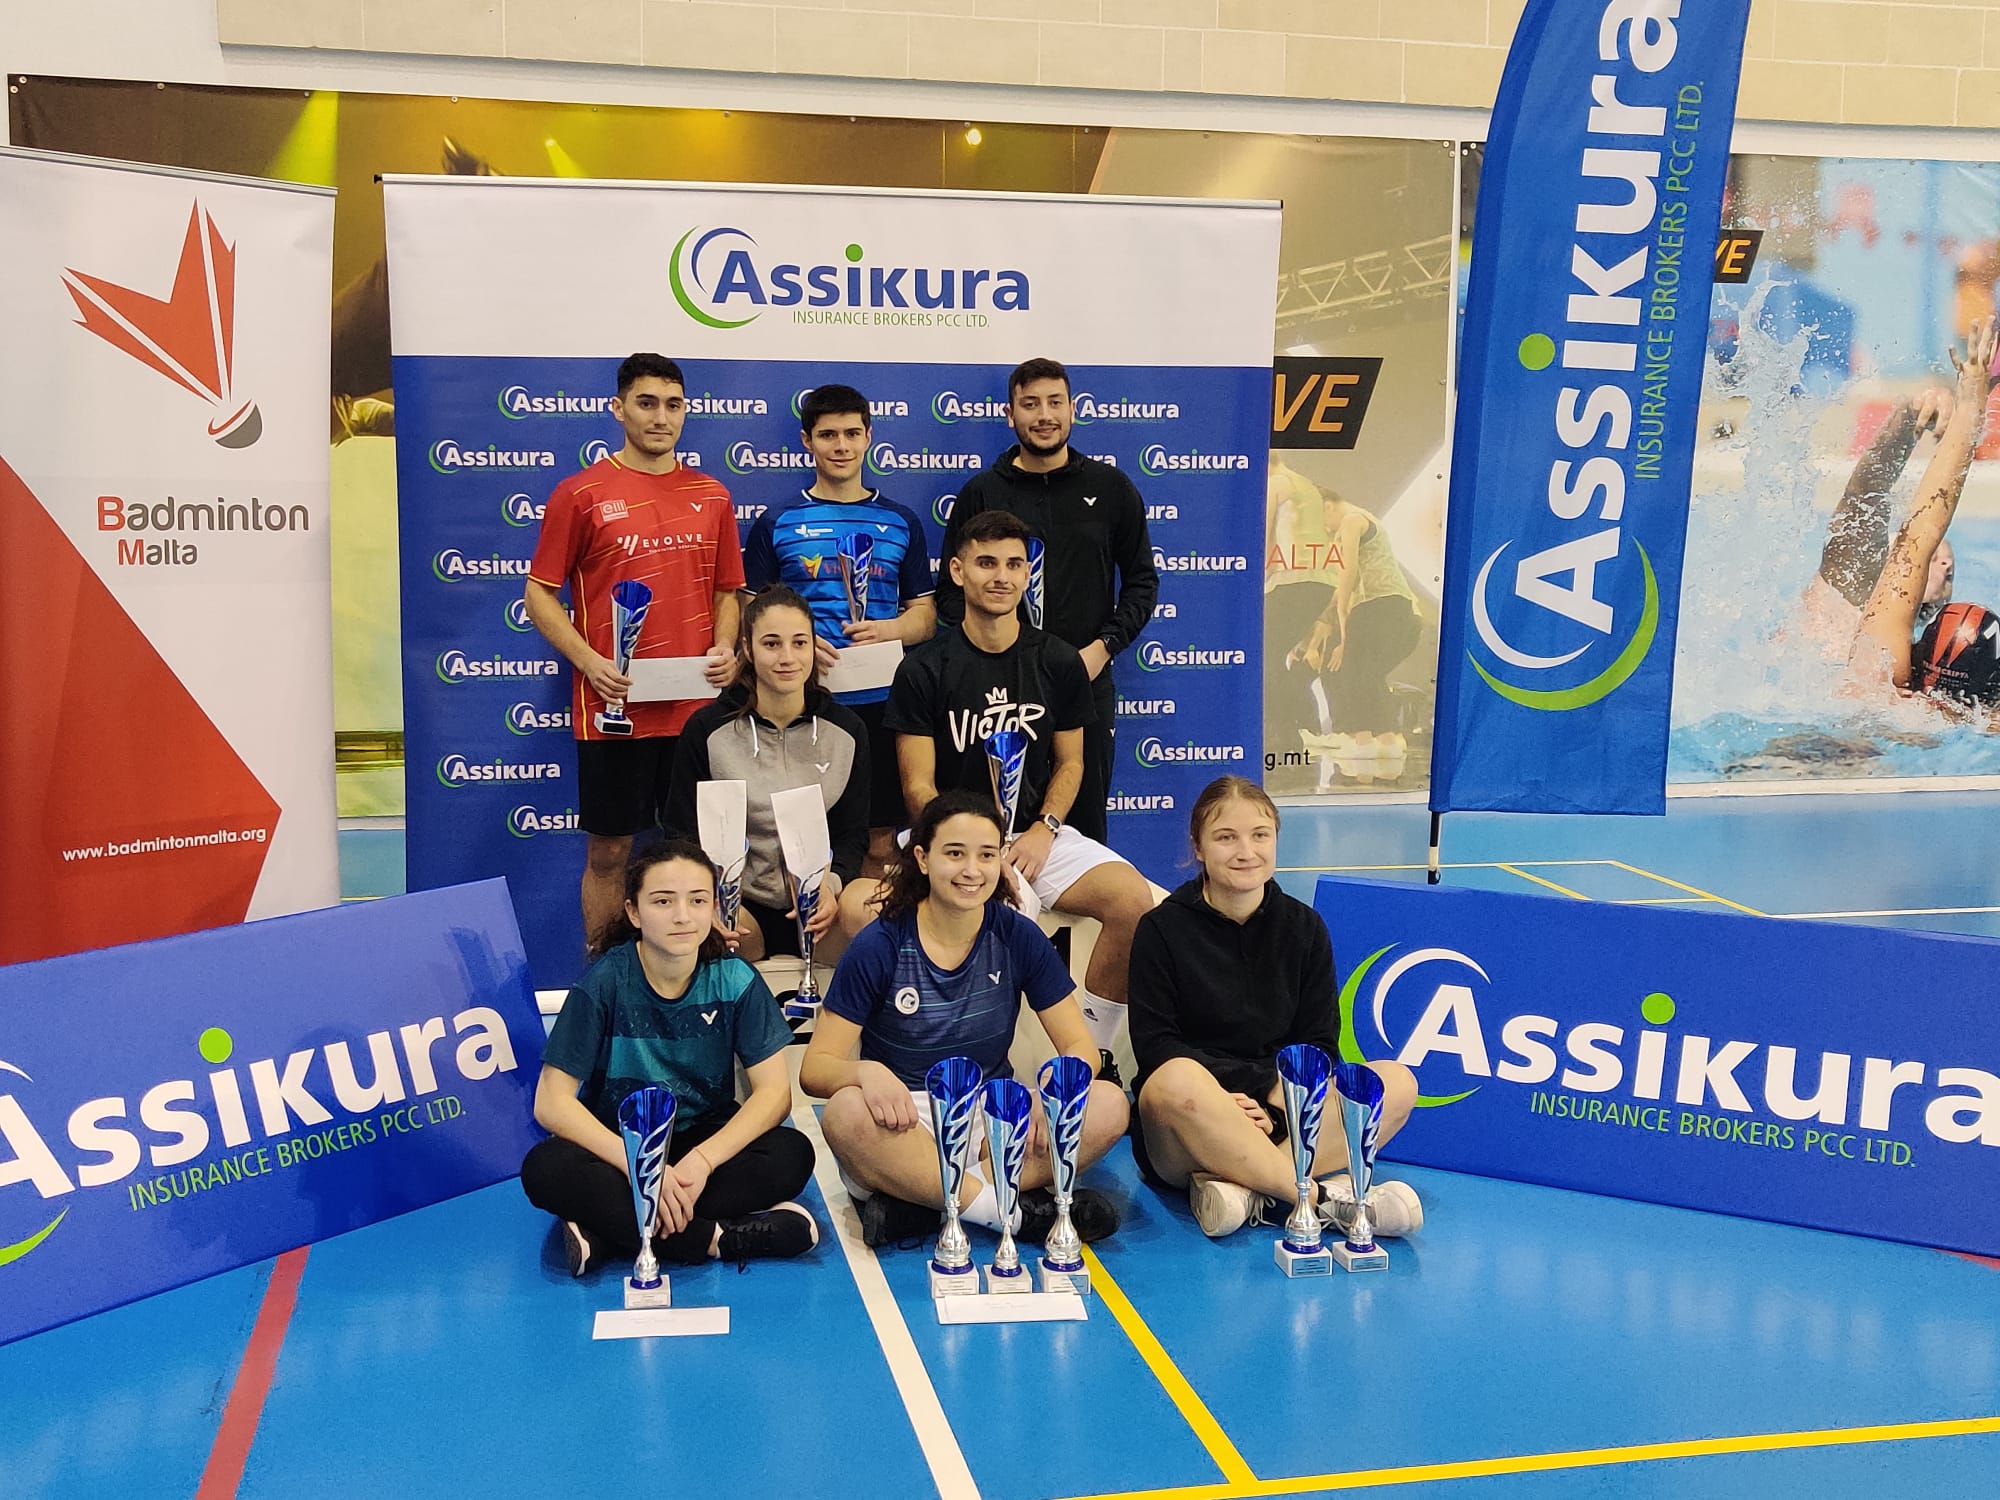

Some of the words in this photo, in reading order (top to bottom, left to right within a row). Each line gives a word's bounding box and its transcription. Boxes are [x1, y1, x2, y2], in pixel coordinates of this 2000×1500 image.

[1675, 81, 1704, 130] LTD.
[1665, 140, 1696, 191] PCC
[1650, 202, 1688, 321] BROKERS
[712, 243, 1031, 311] Assikura
[793, 310, 868, 326] INSURANCE
[873, 311, 932, 327] BROKERS
[937, 312, 961, 328] PCC
[966, 313, 990, 328] LTD.
[1515, 0, 1682, 635] Assikura
[683, 391, 768, 415] ssikura
[944, 396, 1010, 417] Assik
[1080, 397, 1179, 418] Assikura
[1635, 329, 1674, 479] INSURANCE
[443, 444, 555, 467] Assikura
[738, 446, 817, 468] Assiku
[880, 447, 982, 469] Assikura
[1151, 448, 1249, 470] Assikura
[97, 495, 310, 531] Badminton
[118, 538, 198, 566] Malta
[642, 533, 703, 549] EVOLVE
[447, 552, 532, 575] Assiku
[1153, 550, 1247, 571] Assikura
[450, 654, 559, 677] Assikura
[1149, 644, 1246, 665] Assikura
[1115, 694, 1176, 715] ikura
[519, 705, 571, 728] Assi
[1147, 740, 1244, 761] Assikura
[450, 757, 561, 780] Assikura
[1106, 790, 1175, 810] sikura
[521, 807, 579, 831] Assi
[62, 828, 267, 861] www.badmintonmalta.org
[1397, 983, 2000, 1147] Assikura
[0, 1006, 518, 1199] Assikura
[1531, 1091, 1671, 1133] INSURANCE
[1679, 1112, 1795, 1150] BROKERS
[1803, 1130, 1856, 1160] PCC
[1866, 1138, 1917, 1168] LTD.
[128, 1147, 273, 1211] INSURANCE
[278, 1118, 376, 1168] BROKERS
[382, 1107, 421, 1137] PCC
[426, 1096, 467, 1126] LTD.
